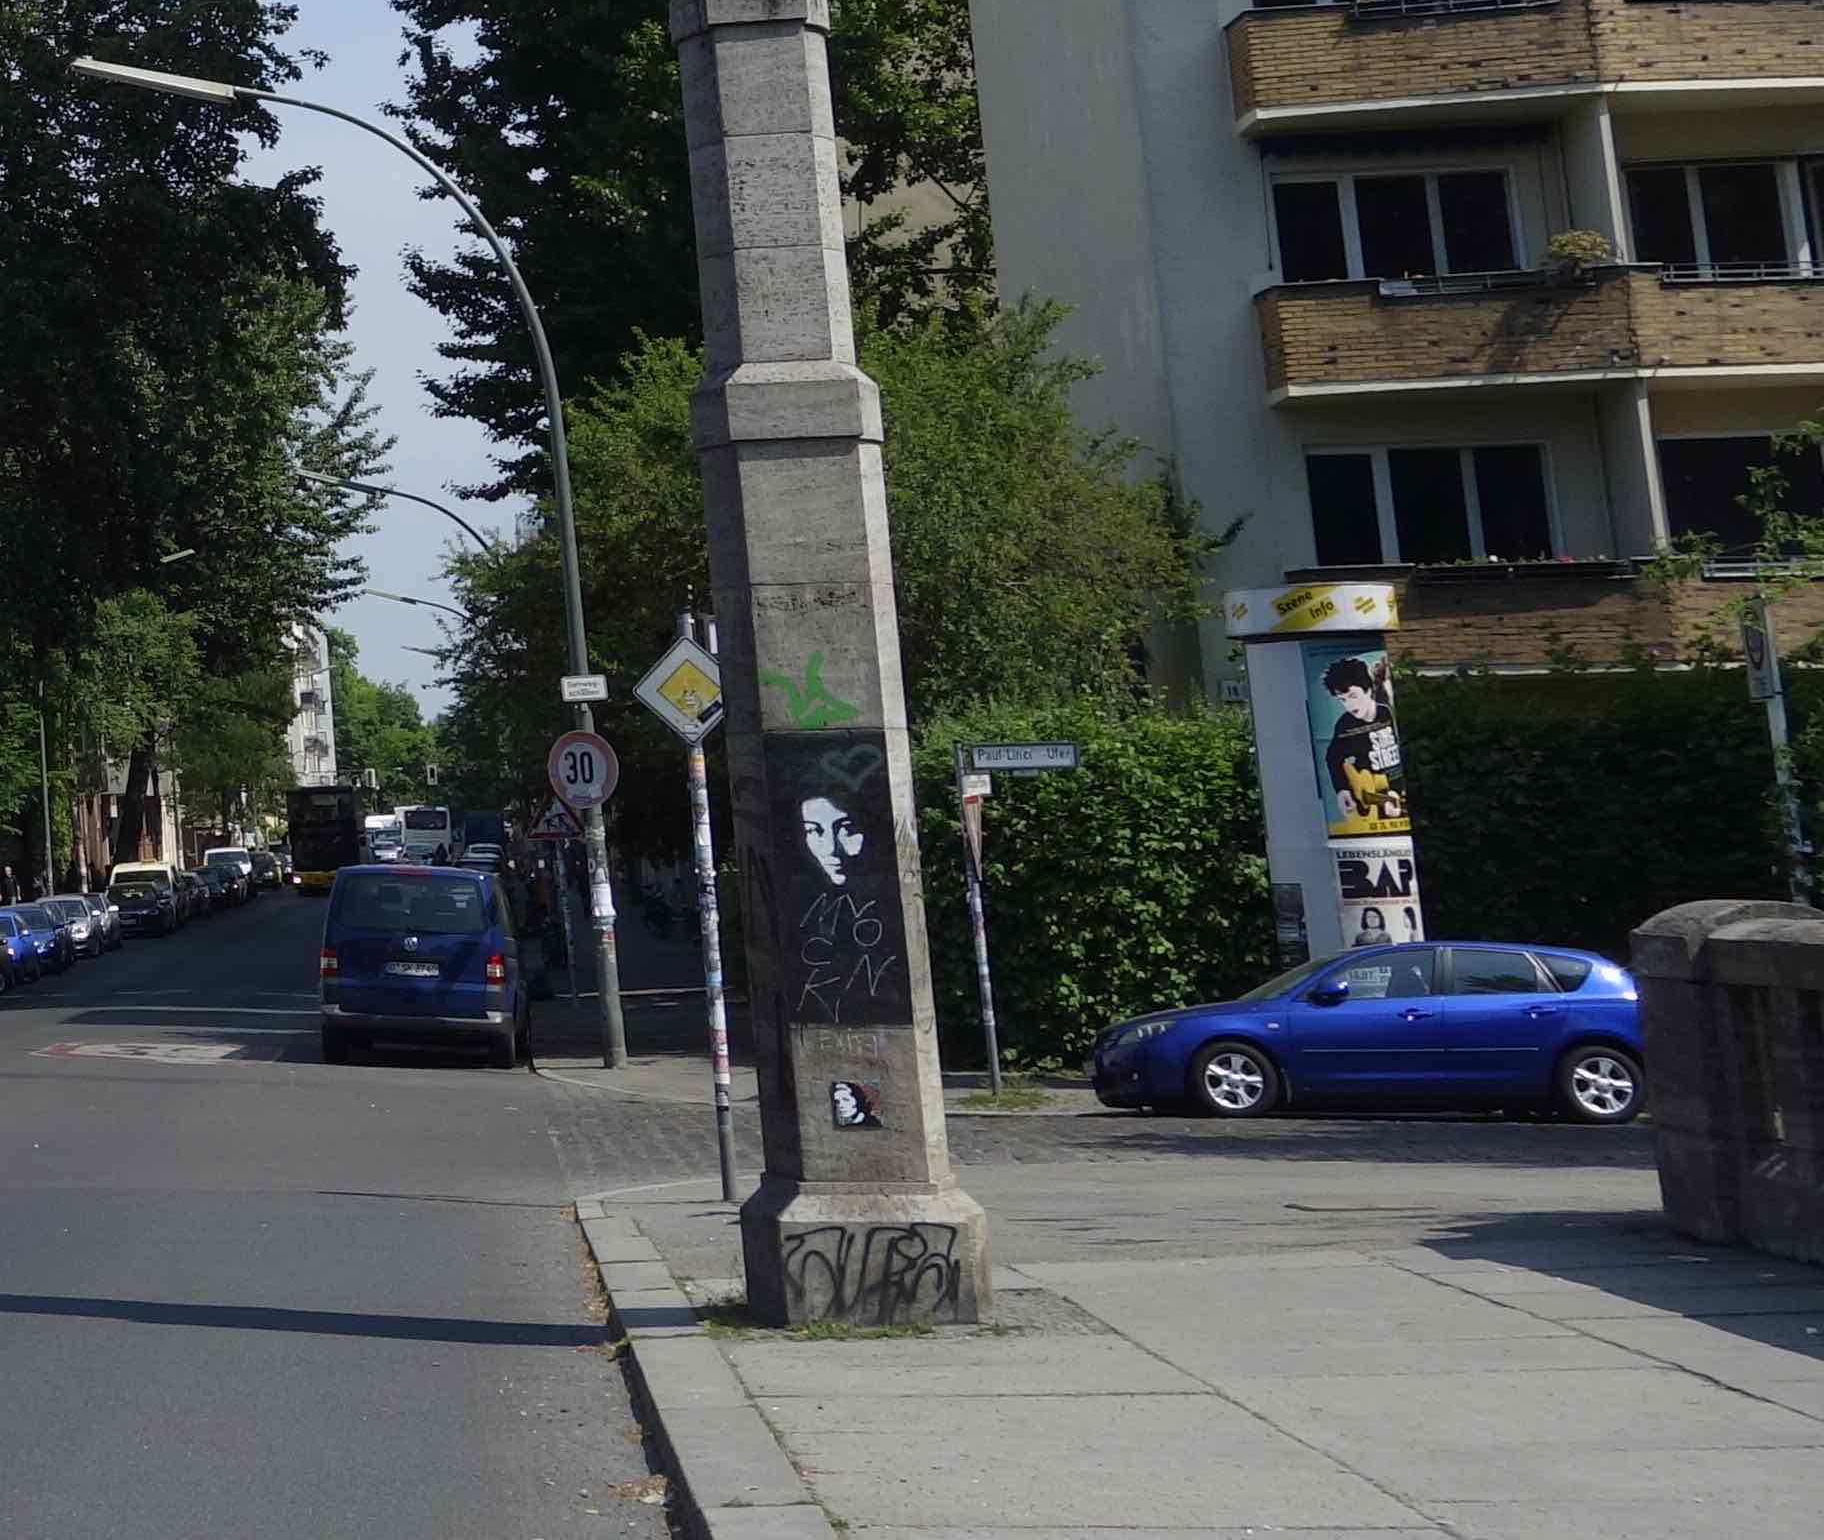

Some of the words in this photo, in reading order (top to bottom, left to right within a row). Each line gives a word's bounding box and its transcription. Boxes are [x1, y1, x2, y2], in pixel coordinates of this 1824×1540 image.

[1309, 600, 1335, 620] Info
[564, 751, 594, 784] 30
[1337, 859, 1413, 898] BAP
